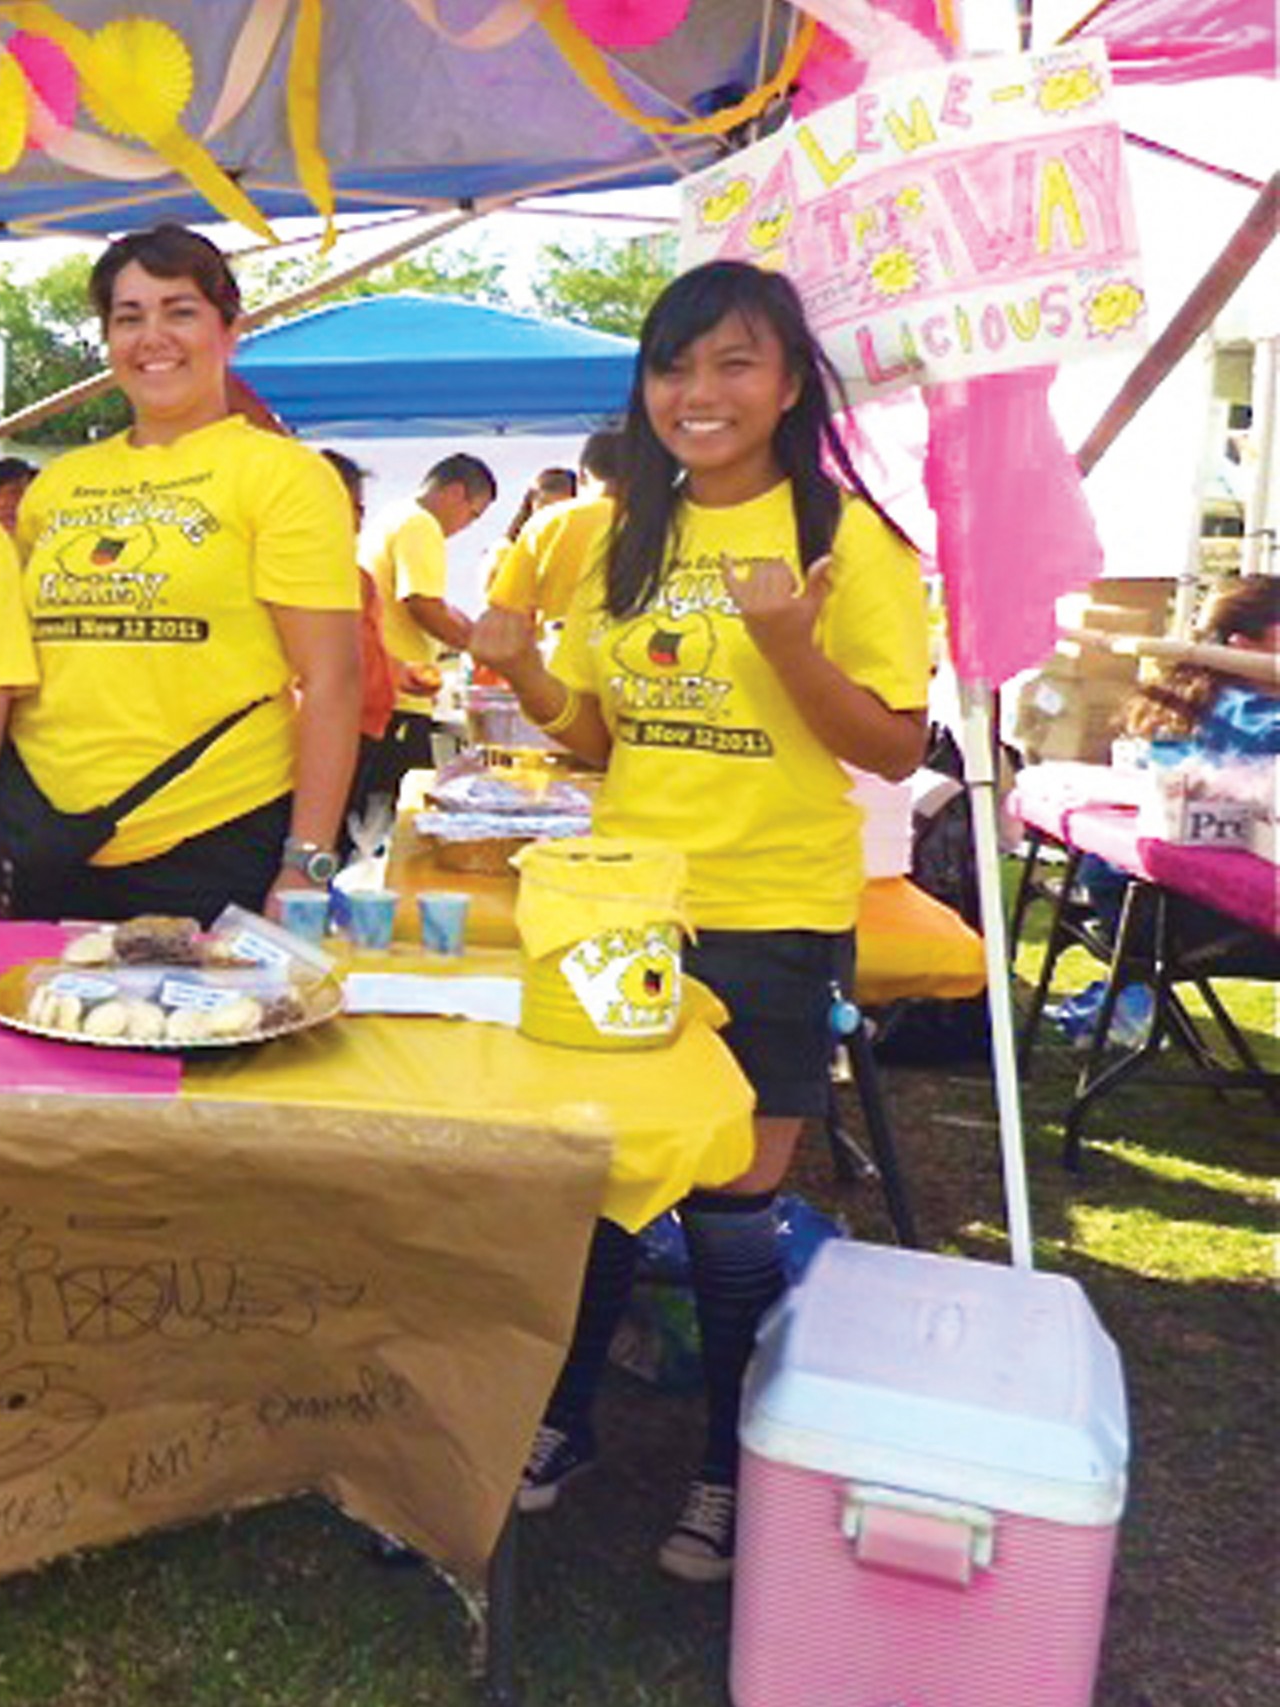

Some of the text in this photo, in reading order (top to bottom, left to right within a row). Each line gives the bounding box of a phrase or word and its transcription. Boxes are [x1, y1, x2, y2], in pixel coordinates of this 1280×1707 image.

[932, 142, 1124, 274] WAY
[854, 284, 1073, 386] LICIOUS
[80, 621, 120, 637] Nov
[122, 622, 147, 637] 12
[150, 622, 202, 639] 2011
[644, 723, 690, 743] Nov
